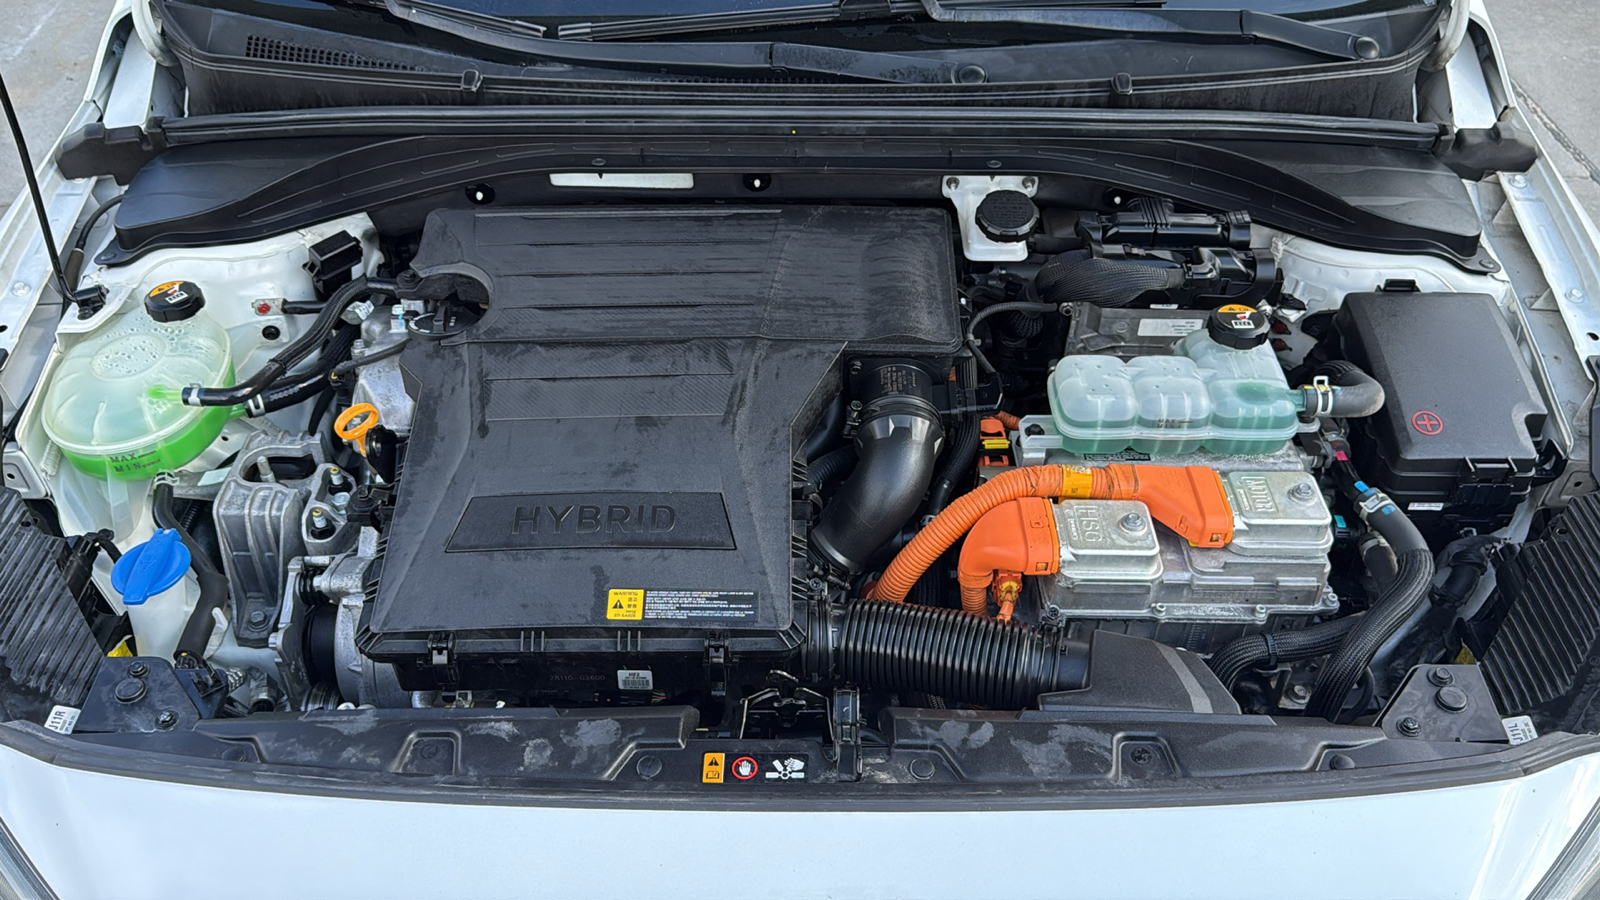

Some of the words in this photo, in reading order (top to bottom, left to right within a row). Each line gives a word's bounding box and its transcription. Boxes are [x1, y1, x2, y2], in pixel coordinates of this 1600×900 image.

[110, 453, 137, 463] MAX
[114, 462, 141, 472] MIN
[1245, 480, 1275, 512] MOTOR
[511, 505, 676, 535] HYBRID
[1079, 510, 1102, 542] HSG
[48, 710, 66, 730] J11R
[1508, 723, 1524, 741] J11L
